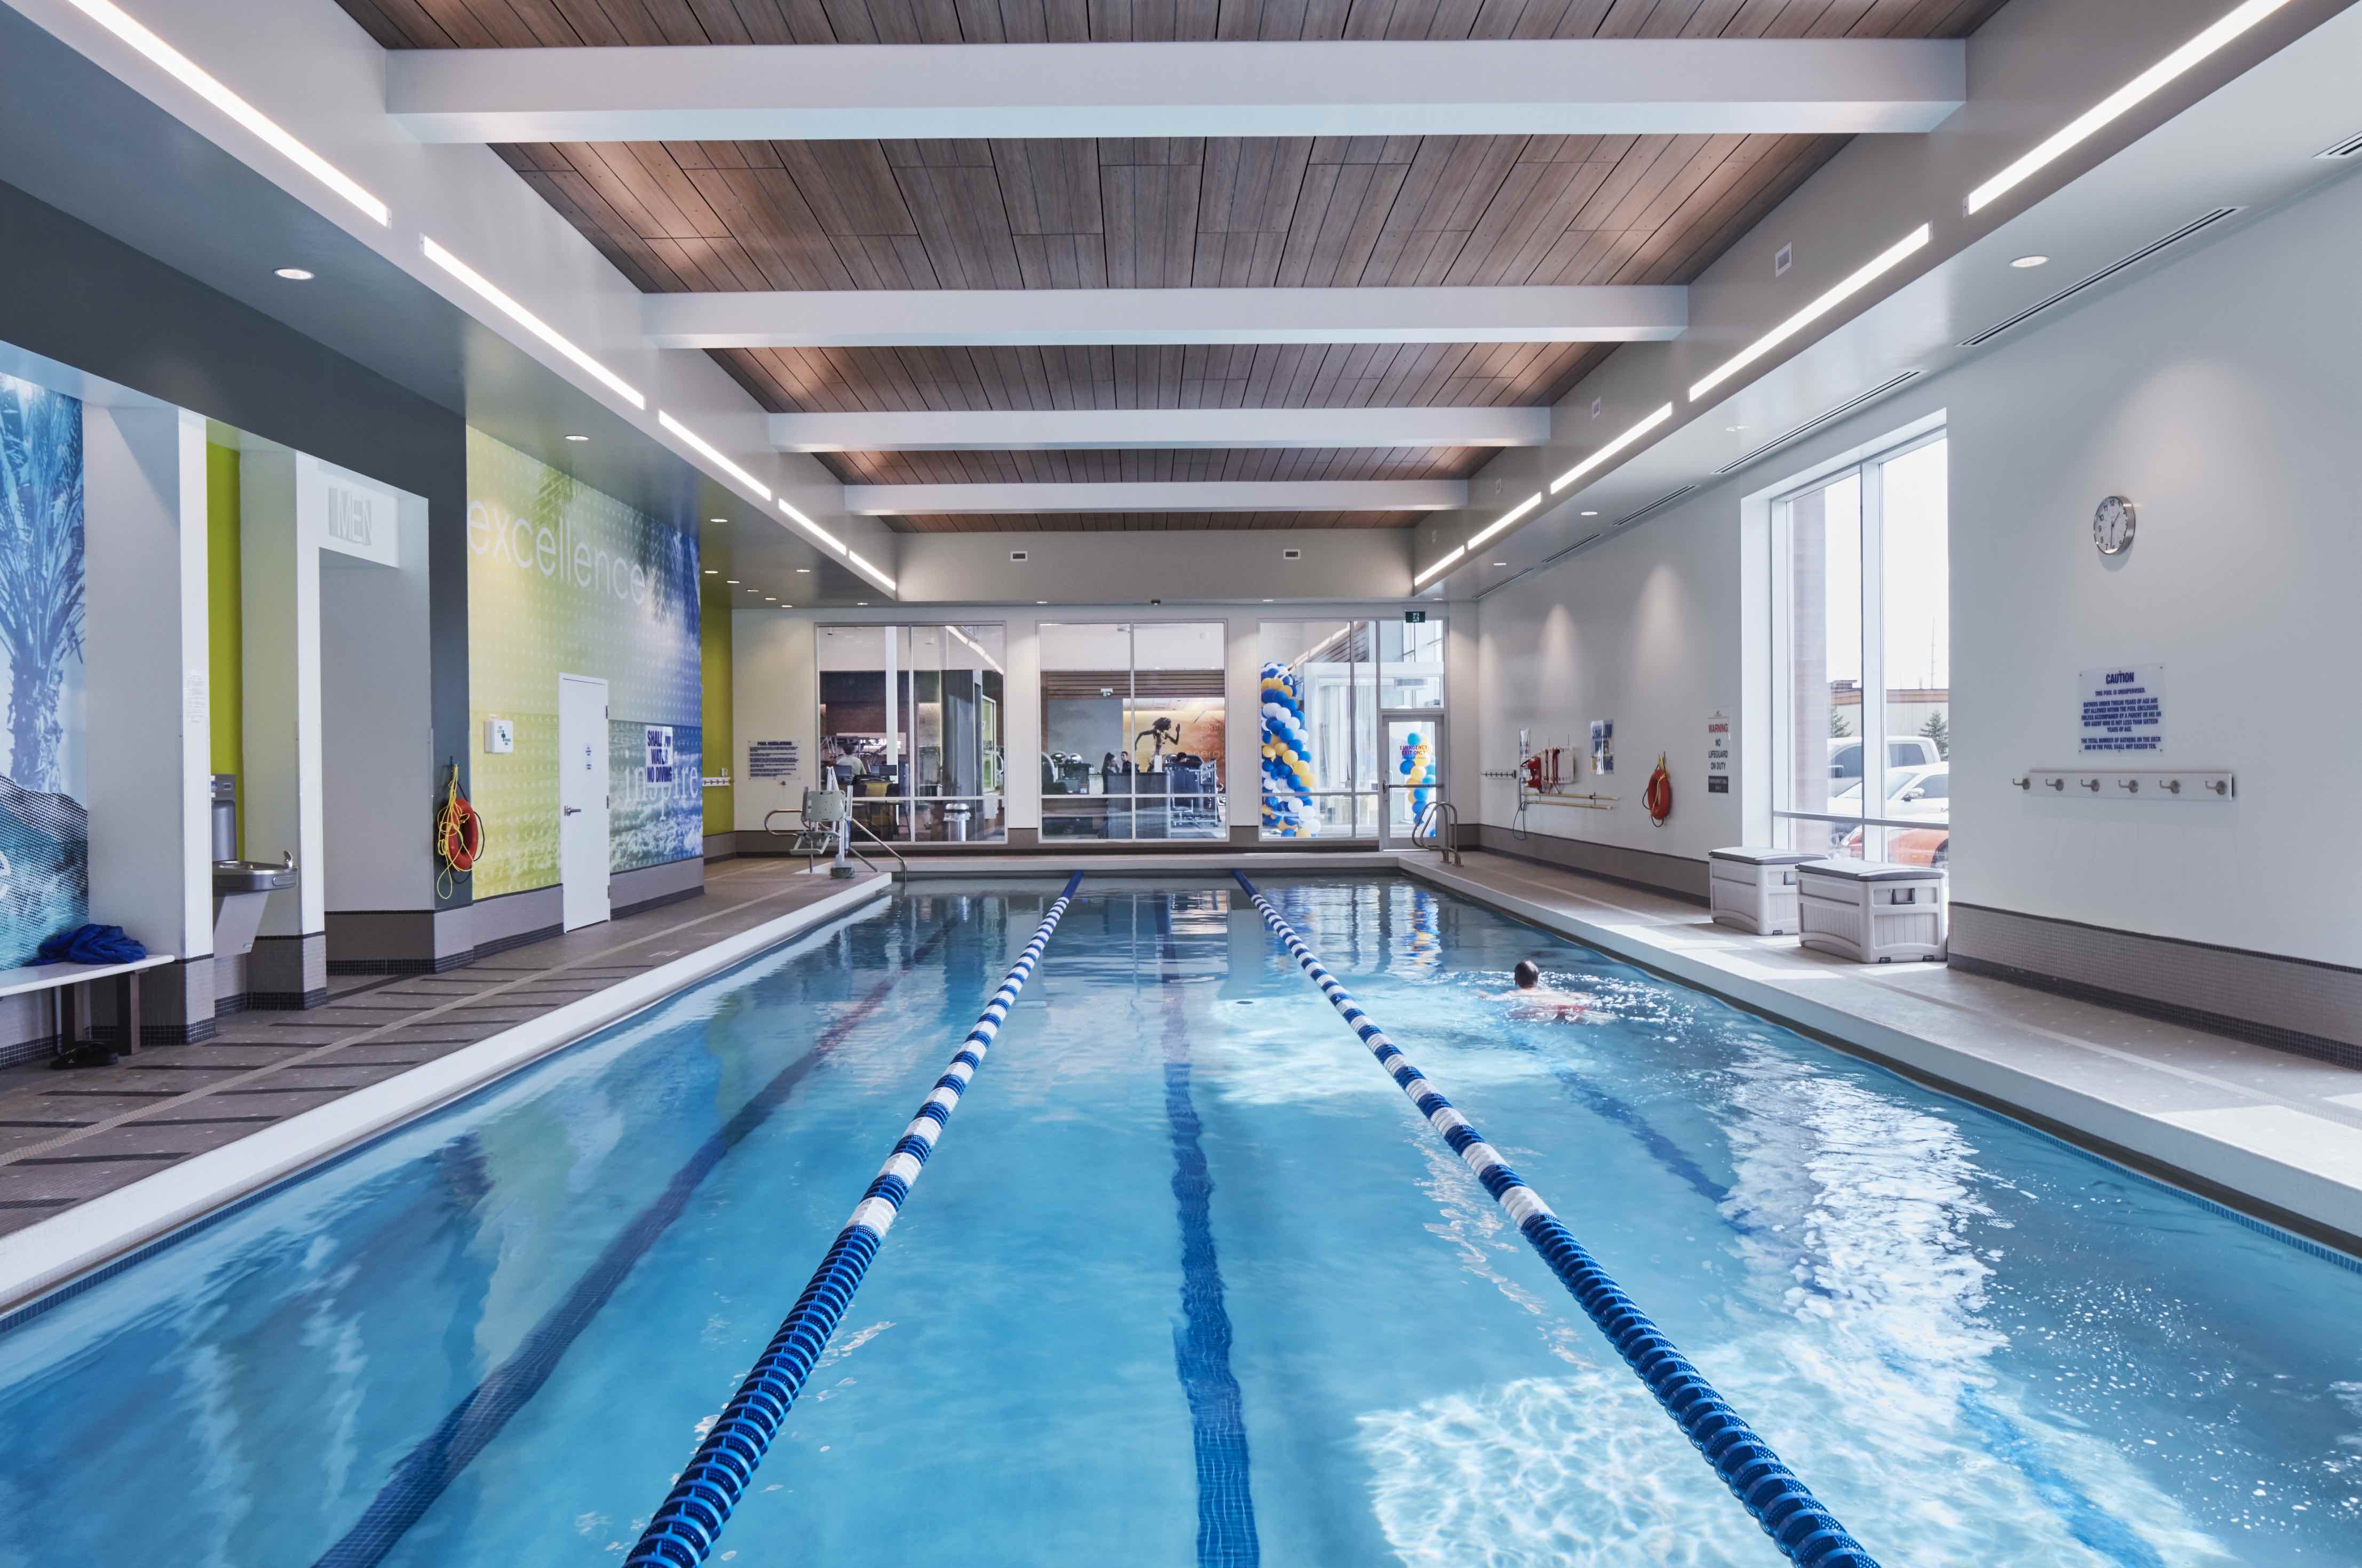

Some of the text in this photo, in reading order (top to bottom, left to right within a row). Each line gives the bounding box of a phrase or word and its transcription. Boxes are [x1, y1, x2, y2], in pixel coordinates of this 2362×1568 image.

[335, 489, 372, 545] MEN
[467, 500, 646, 604] excellence
[2106, 672, 2134, 684] CAUTION
[1708, 724, 1728, 733] WARNING
[1708, 750, 1727, 758] LIFEGUARD
[1710, 762, 1726, 770] ON DUTY
[647, 767, 672, 782] NO DIVING
